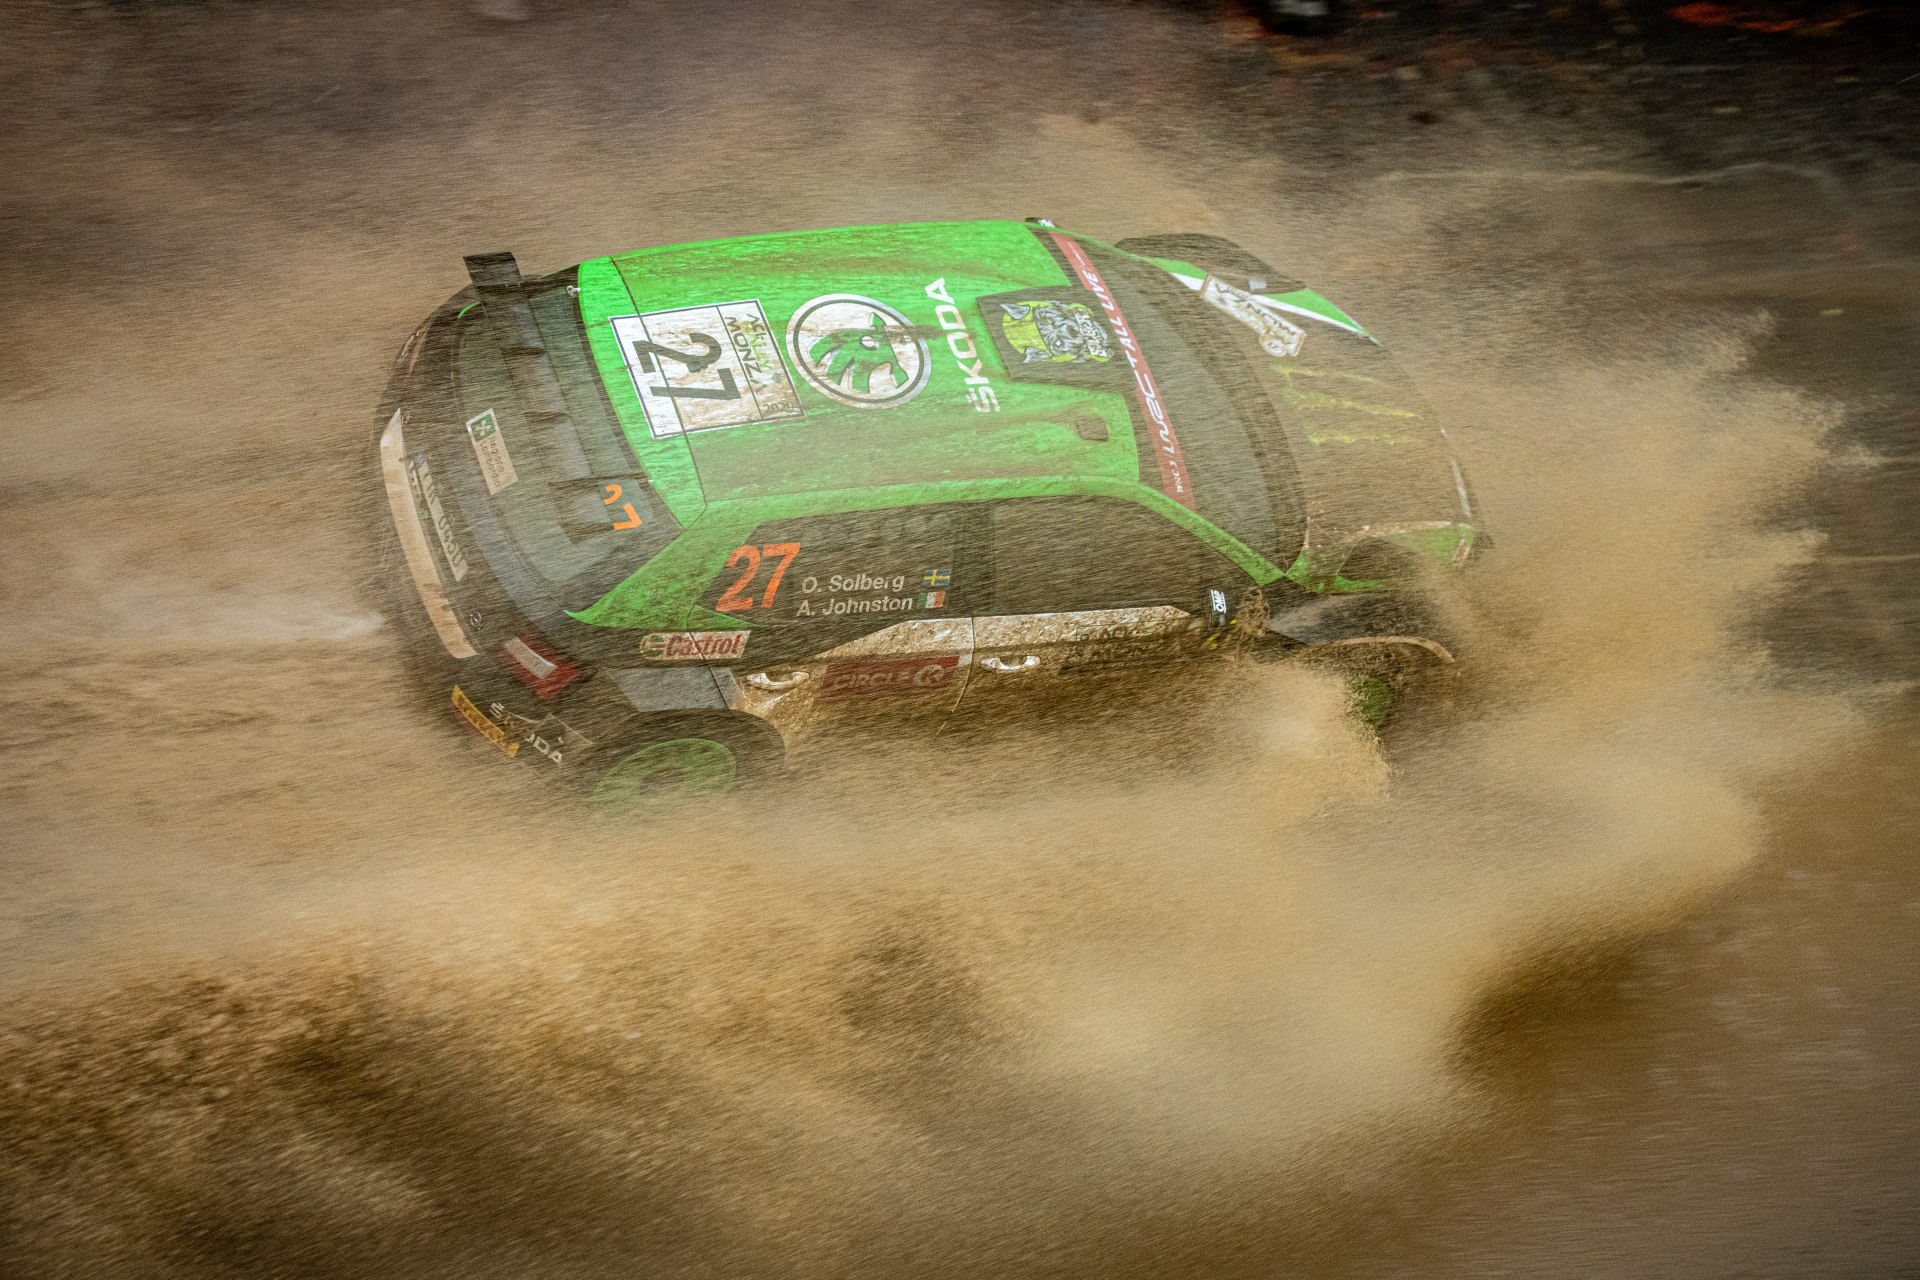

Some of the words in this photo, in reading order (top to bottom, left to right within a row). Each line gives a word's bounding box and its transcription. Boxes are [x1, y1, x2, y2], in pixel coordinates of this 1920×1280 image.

[1082, 269, 1115, 311] LIVE
[924, 277, 1001, 413] ŠKODA
[1109, 316, 1137, 352] ALL
[632, 333, 742, 400] 27
[603, 483, 643, 531] 27
[715, 541, 801, 612] 27
[801, 576, 823, 594] O.
[829, 572, 906, 592] Solberg
[796, 601, 818, 618] A.
[822, 597, 914, 616] Johnston
[1213, 590, 1225, 612] OMP
[665, 633, 742, 657] Castrol
[489, 702, 563, 764] ŠDA
